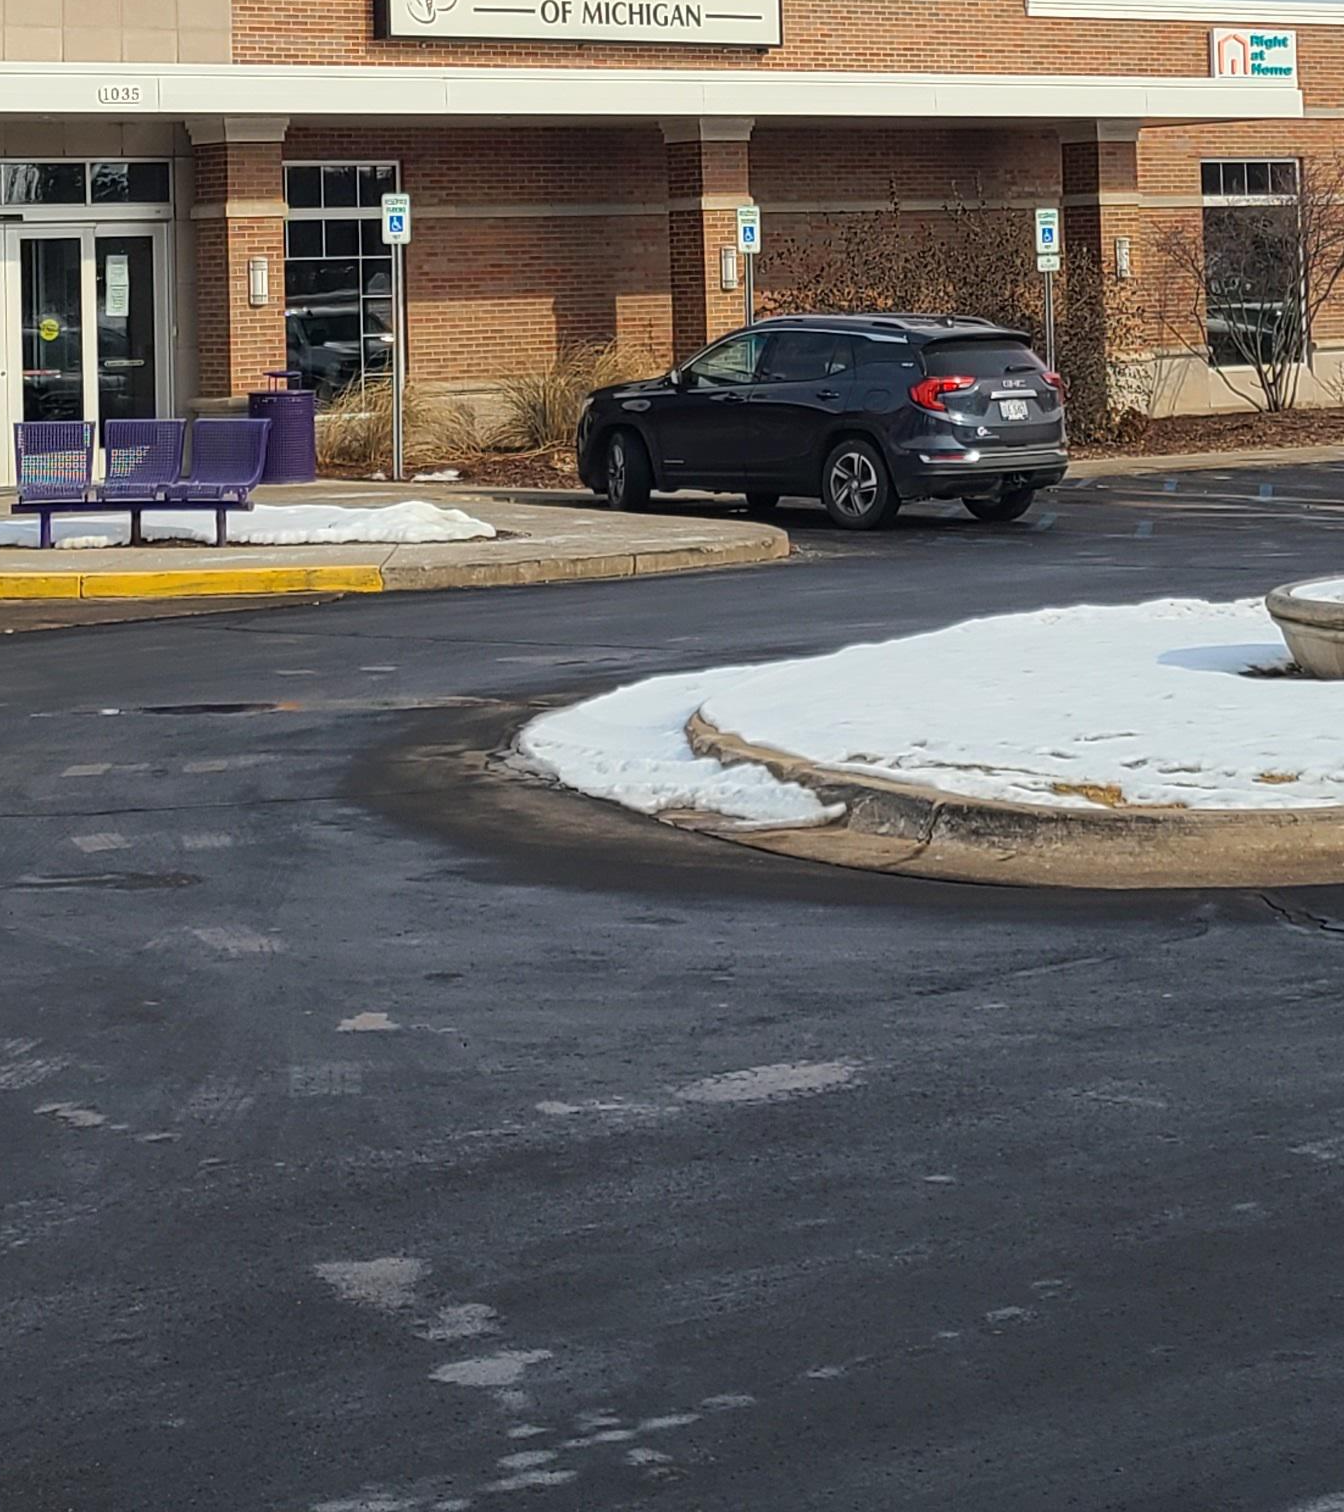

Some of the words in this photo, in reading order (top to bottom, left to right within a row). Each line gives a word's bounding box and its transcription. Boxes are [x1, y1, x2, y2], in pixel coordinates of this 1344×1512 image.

[540, 0, 573, 24] OF
[582, 1, 702, 27] MICHIGAN
[1250, 35, 1289, 50] Right
[1250, 50, 1265, 61] at
[1251, 63, 1293, 76] Home
[103, 87, 140, 101] 1035
